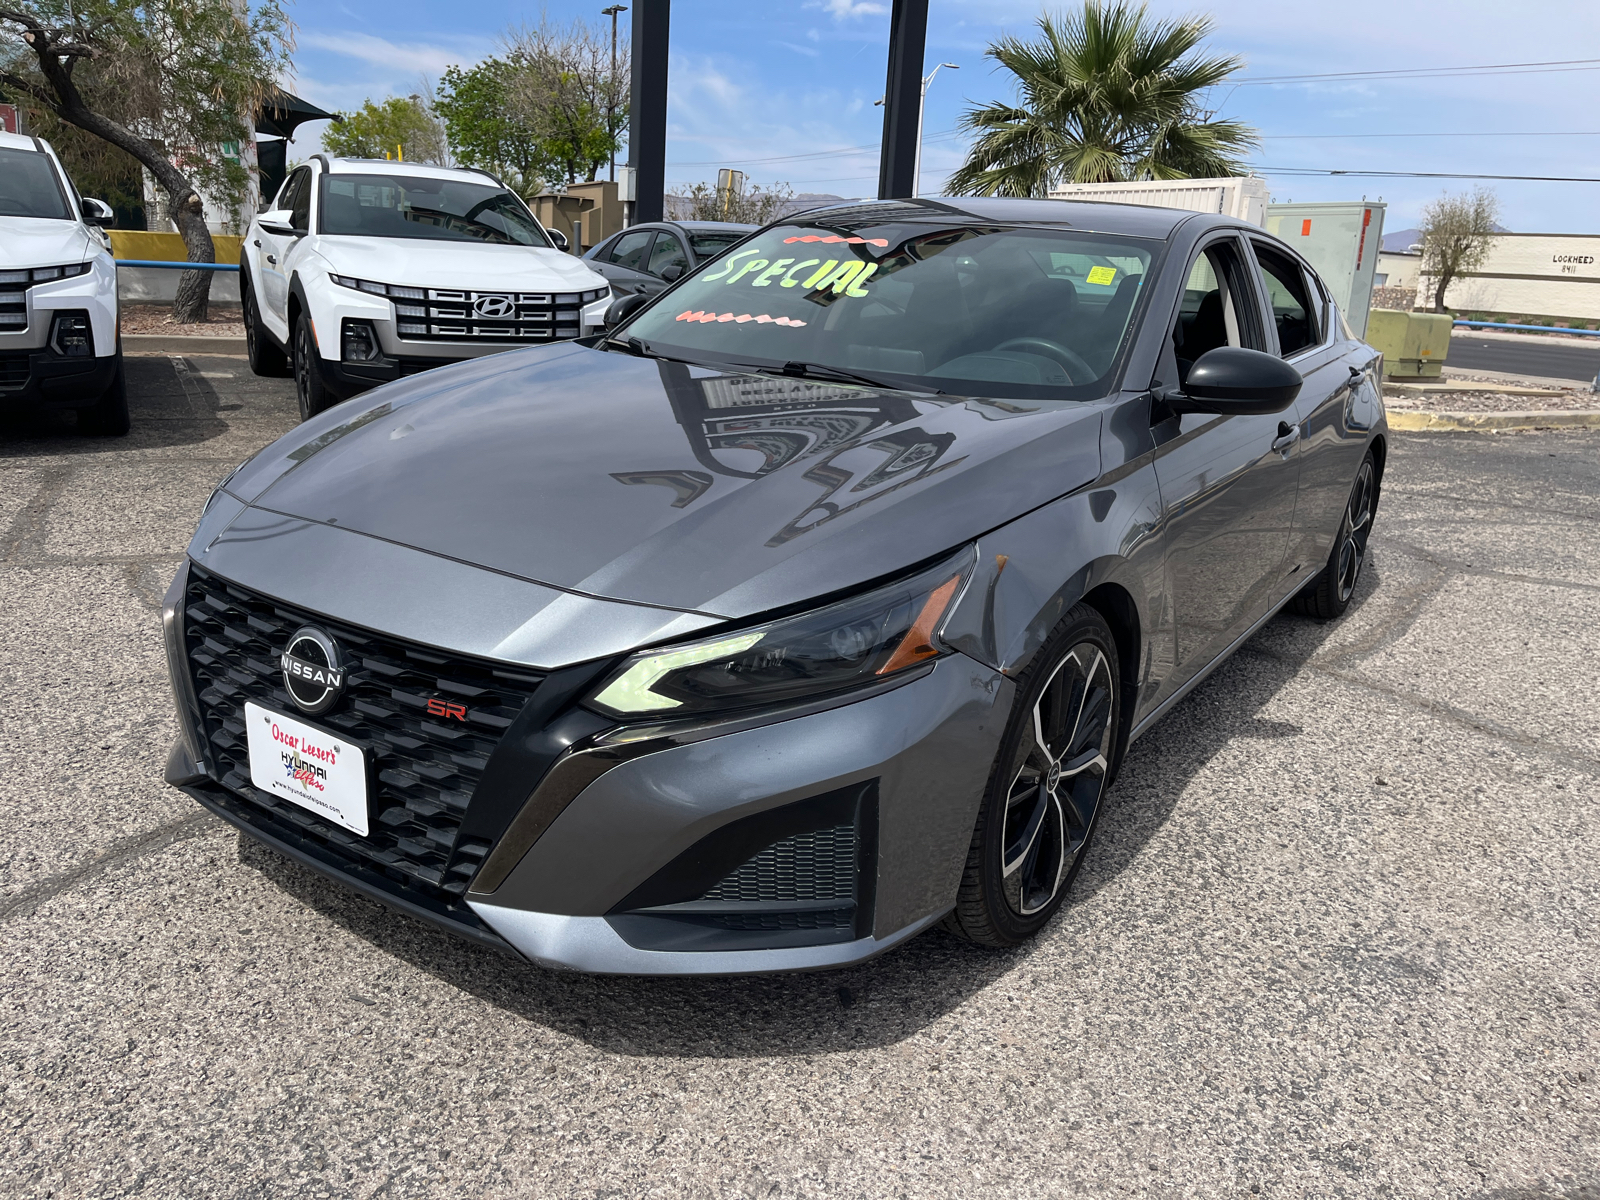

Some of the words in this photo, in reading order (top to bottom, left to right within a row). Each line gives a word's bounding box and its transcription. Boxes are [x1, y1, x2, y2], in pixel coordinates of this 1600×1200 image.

[701, 249, 879, 298] SPECIAL
[1552, 255, 1594, 264] LOCKHEED
[1561, 264, 1577, 274] 8411
[280, 652, 341, 687] NISSAN
[427, 699, 467, 722] SR
[272, 723, 299, 749] Oscar
[301, 737, 336, 765] Leeser's
[281, 751, 327, 780] HYUNDAI
